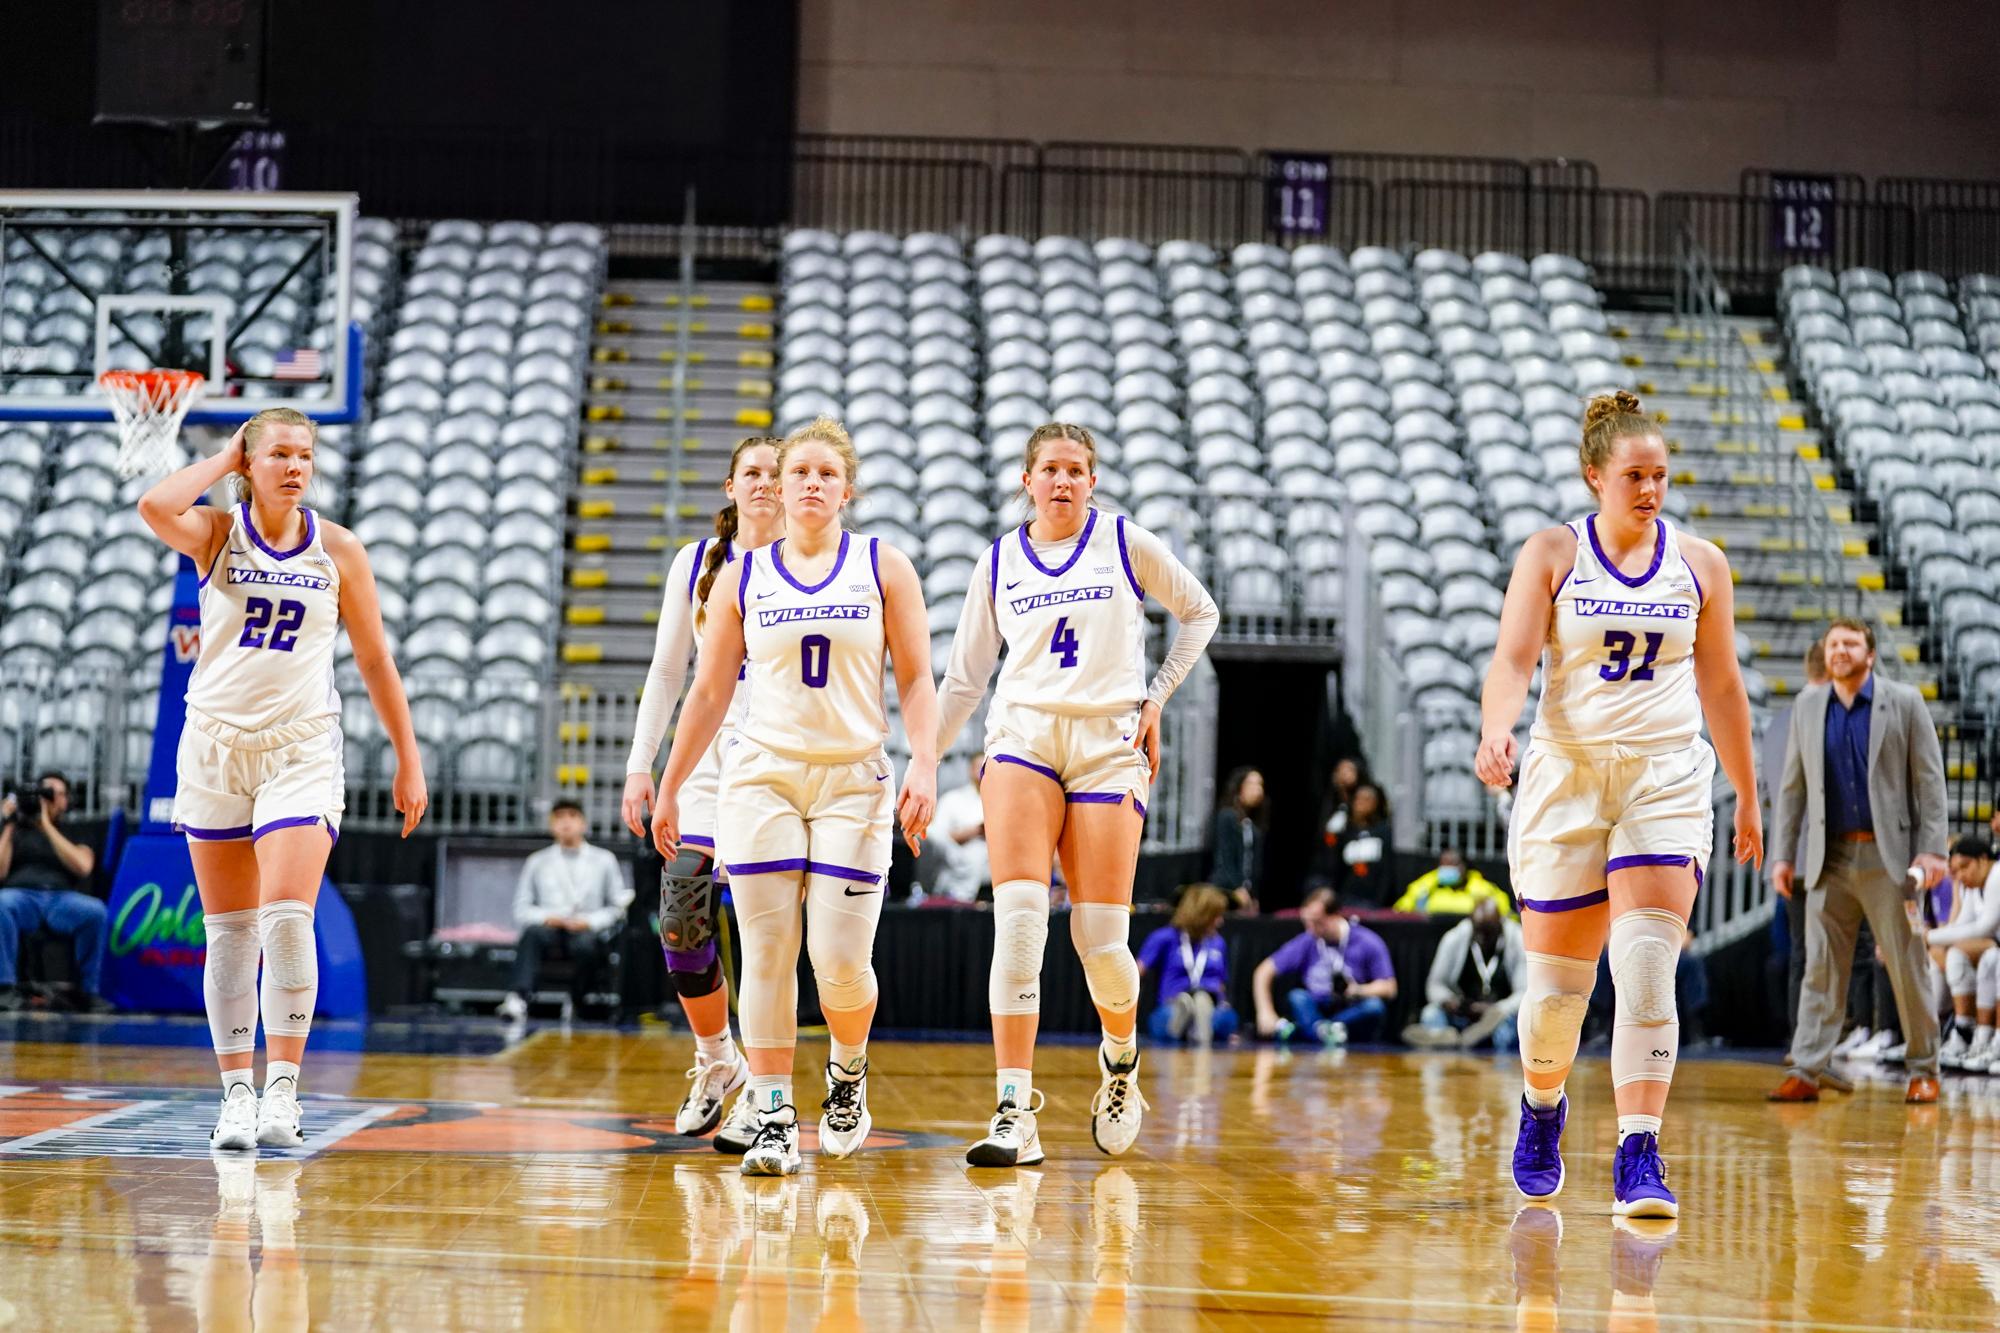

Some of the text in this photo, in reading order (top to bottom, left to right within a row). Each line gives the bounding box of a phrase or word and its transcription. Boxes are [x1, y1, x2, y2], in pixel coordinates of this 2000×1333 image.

[228, 568, 330, 590] WILDCATS
[1093, 566, 1114, 574] WAC
[849, 584, 870, 592] WAC
[1010, 586, 1113, 615] WILDCATS
[760, 606, 869, 627] WILDCATS
[1576, 599, 1689, 618] WILDCATS
[239, 597, 306, 652] 22
[1050, 616, 1079, 668] 4
[801, 634, 831, 688] 0
[1598, 630, 1664, 681] 31
